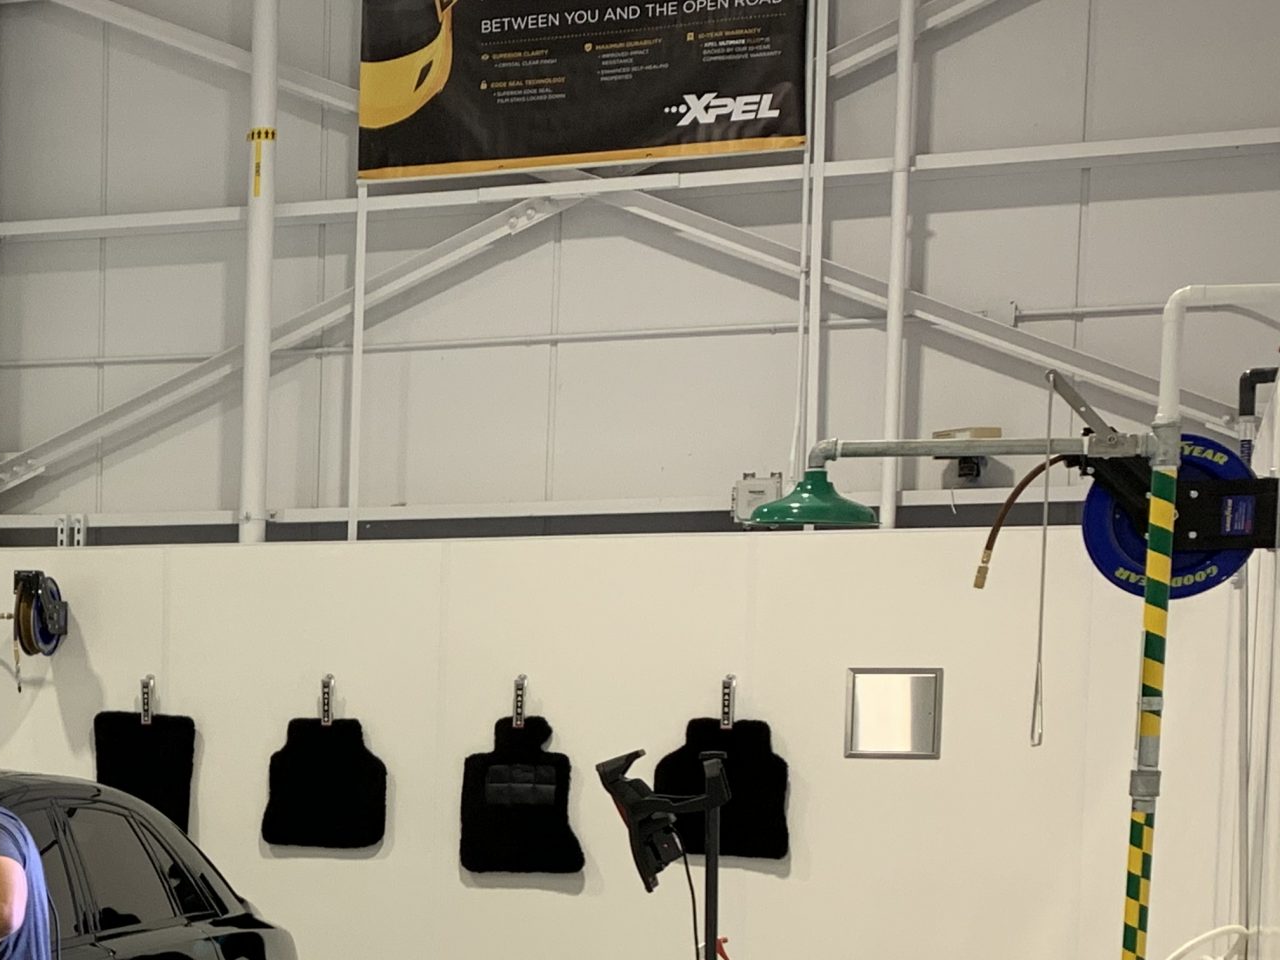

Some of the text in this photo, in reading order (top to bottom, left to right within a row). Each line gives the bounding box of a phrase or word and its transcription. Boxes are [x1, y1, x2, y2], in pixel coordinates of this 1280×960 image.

[481, 12, 560, 34] BETWEEN
[564, 8, 599, 25] YOU
[603, 5, 641, 22] AND
[645, 1, 678, 17] THE
[682, 0, 729, 13] OPEN
[676, 92, 780, 127] XPEL
